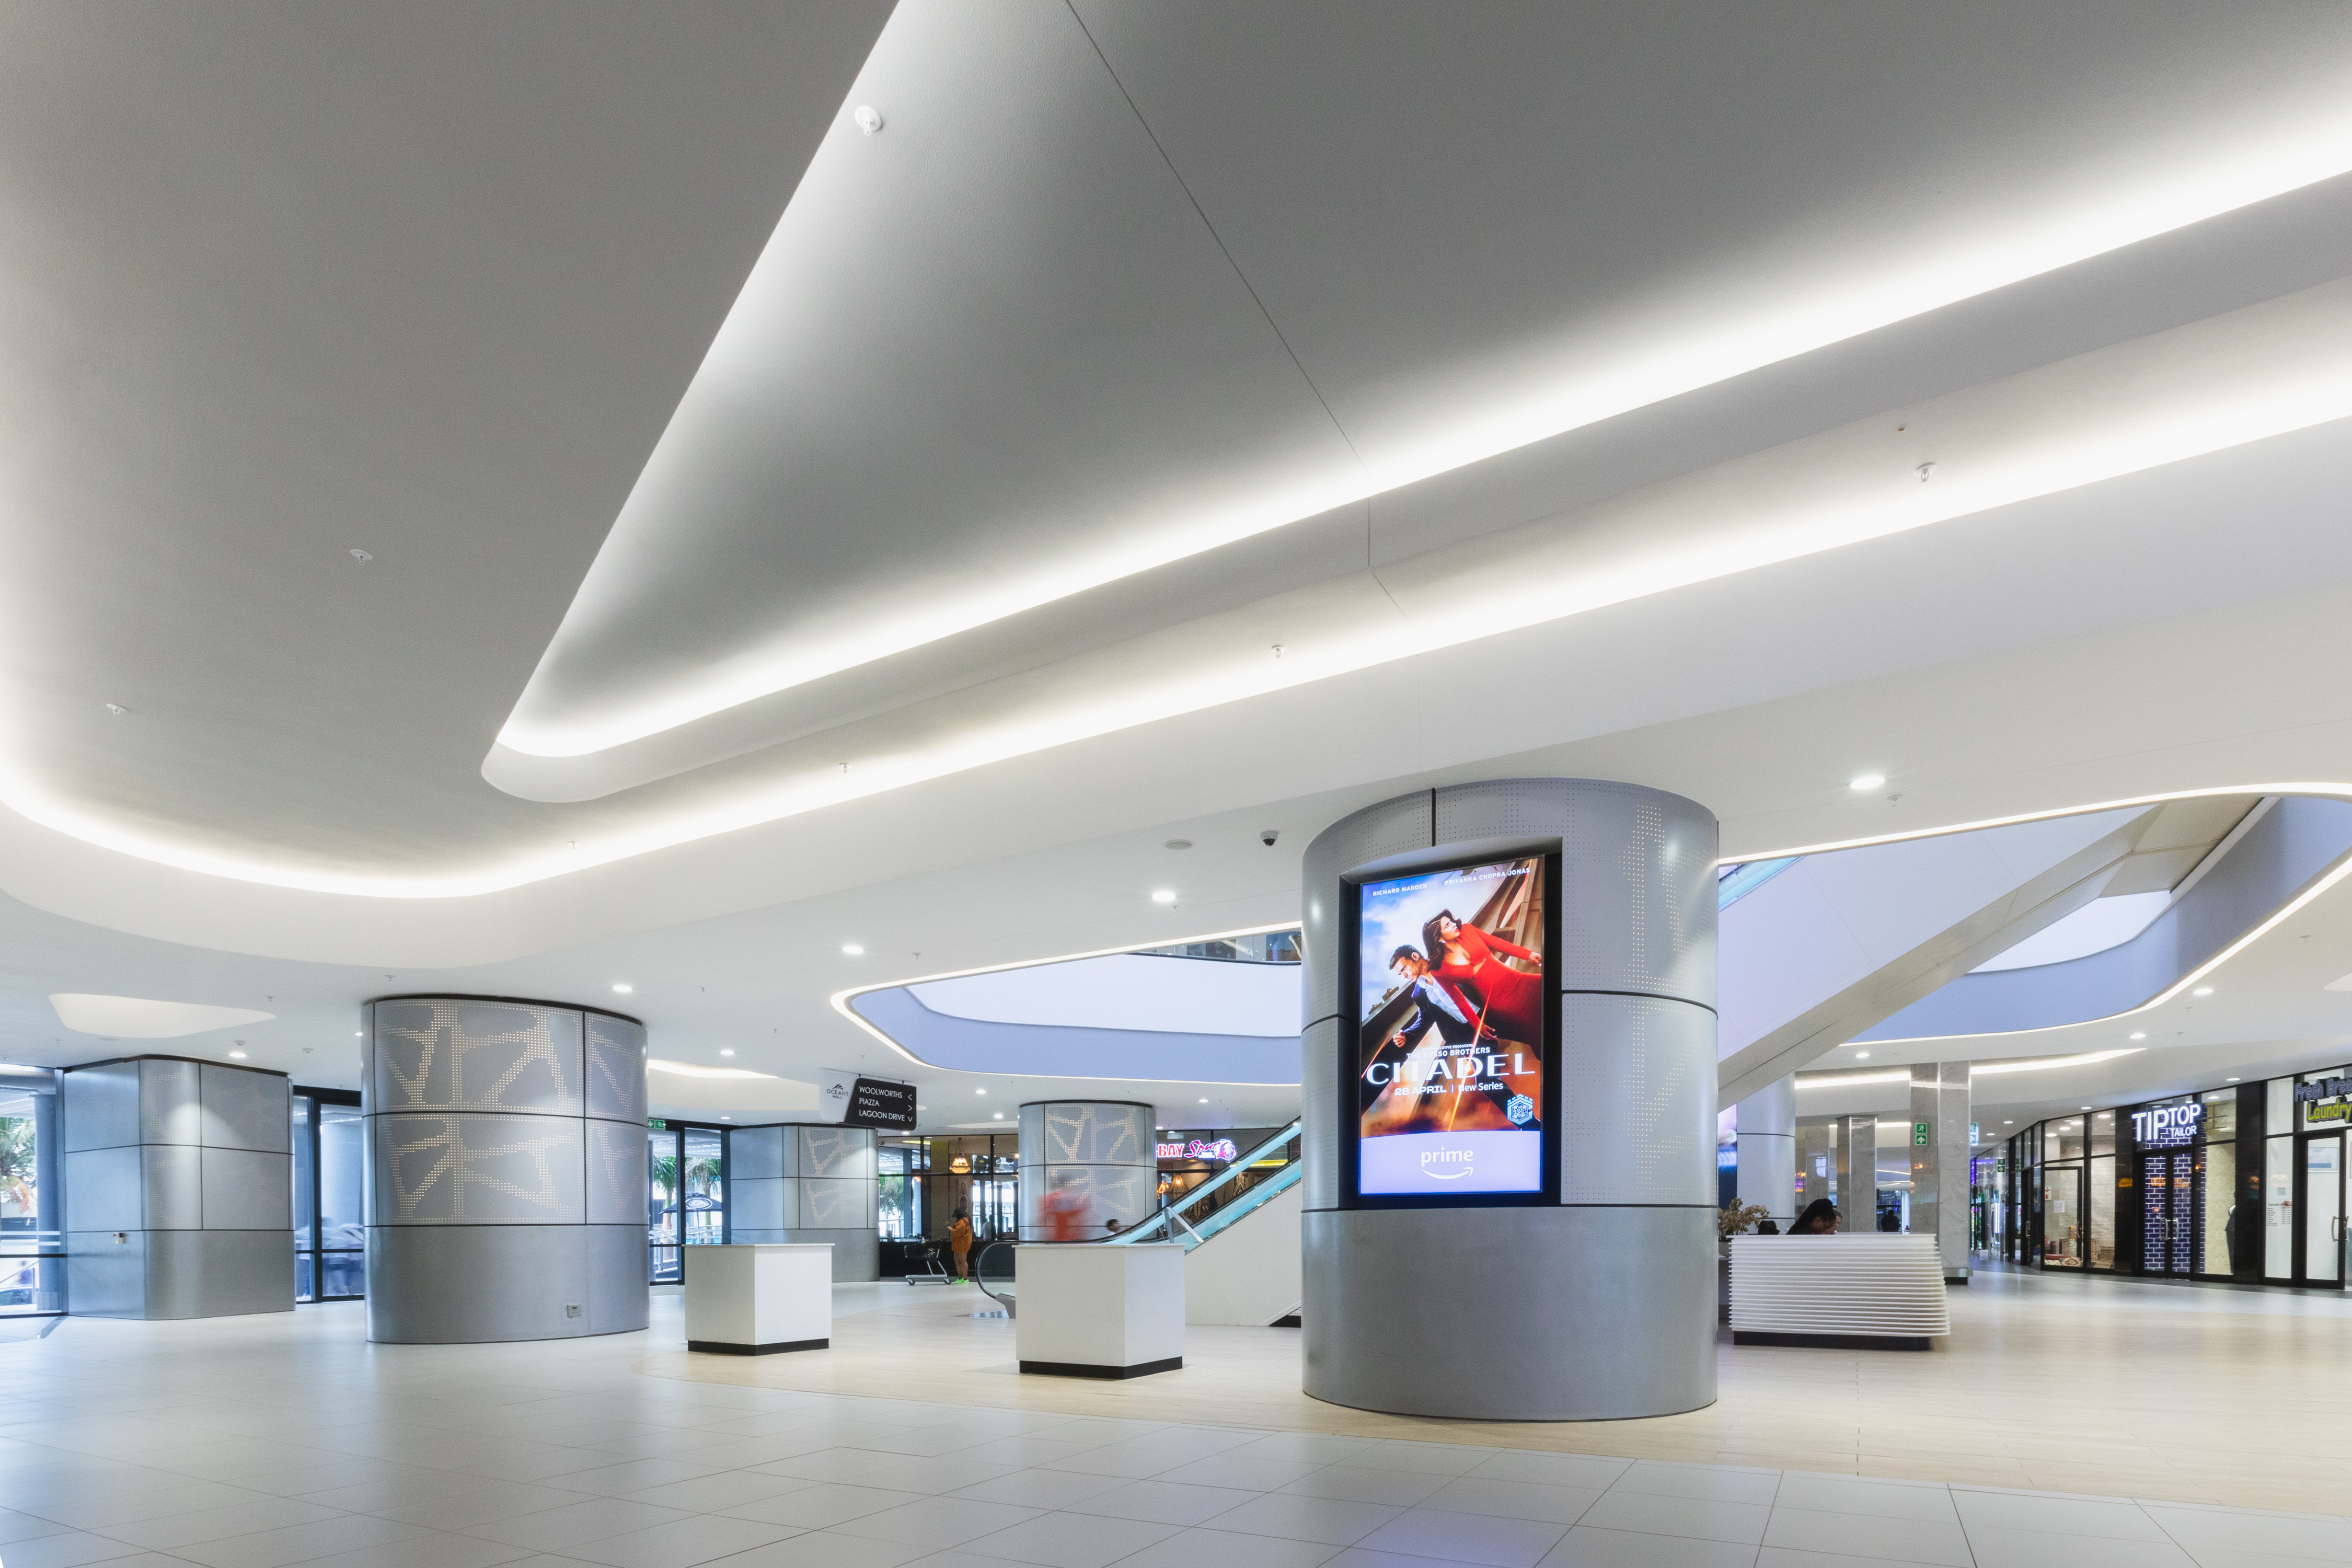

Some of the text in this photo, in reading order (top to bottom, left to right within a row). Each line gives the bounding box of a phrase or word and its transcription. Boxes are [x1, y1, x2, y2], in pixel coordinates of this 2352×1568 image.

[1444, 867, 1531, 885] PRIYANKA CHOPRA JONAS
[1373, 883, 1427, 896] RICHARD MADDEN
[1450, 1047, 1491, 1056] BROTHERS
[1366, 1053, 1536, 1085] CITADEL
[859, 1086, 903, 1099] WOOLWORTHS
[1394, 1082, 1503, 1096] 28 APRIL New Series
[2295, 1082, 2324, 1102] Fresh
[859, 1098, 880, 1107] PIAZZA
[859, 1109, 905, 1122] LAGOON DRIVE
[2307, 1098, 2352, 1123] Laundry
[2170, 1125, 2197, 1138] TAILOR
[1157, 1144, 1184, 1158] BAY
[1421, 1147, 1474, 1167] prime
